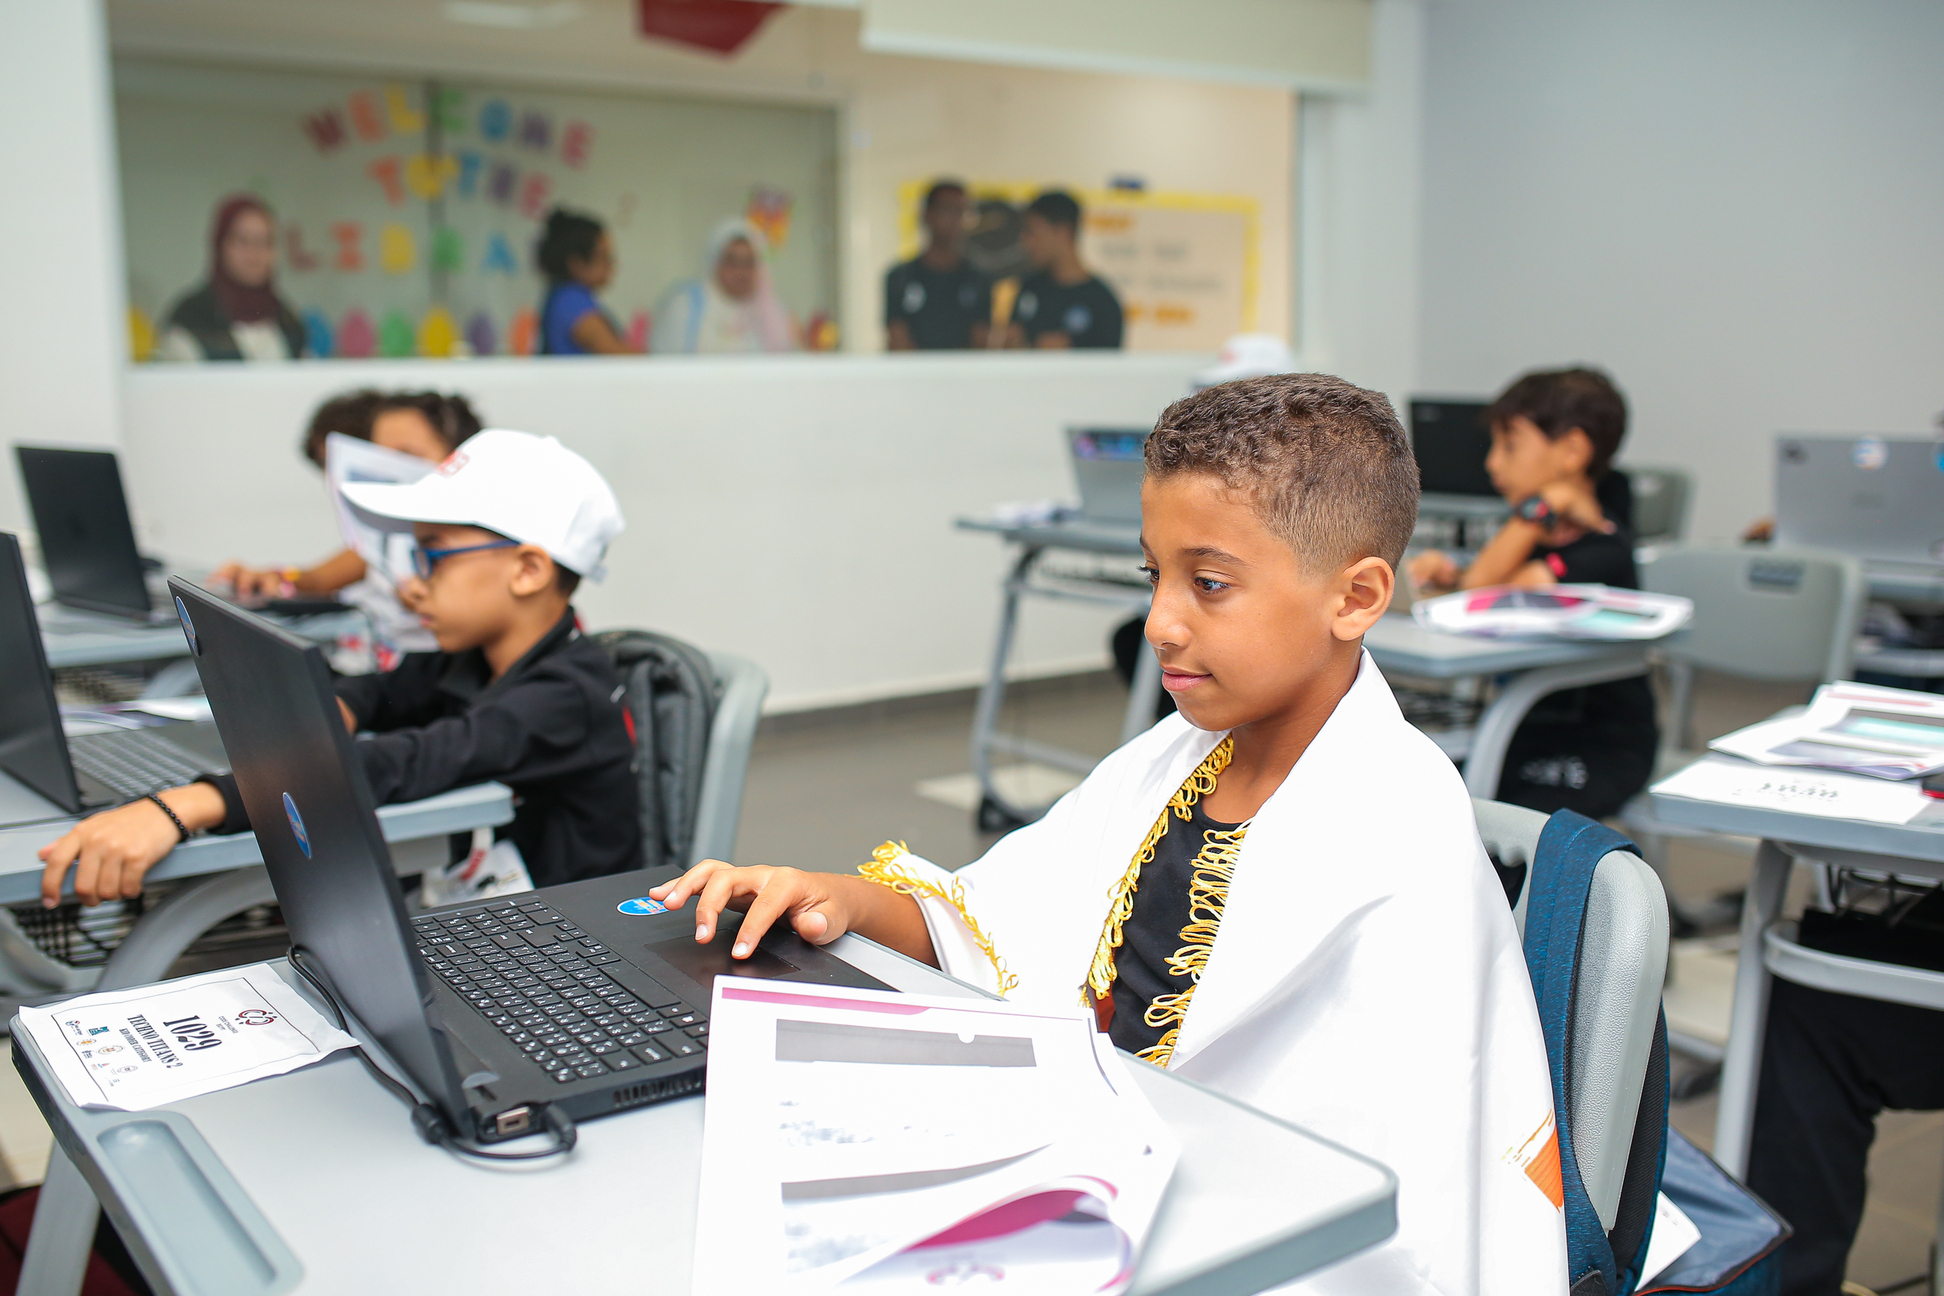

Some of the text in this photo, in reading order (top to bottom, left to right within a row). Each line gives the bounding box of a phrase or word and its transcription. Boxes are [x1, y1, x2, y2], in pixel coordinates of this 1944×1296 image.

[127, 1014, 160, 1040] TECHNO
[146, 1039, 180, 1064] TITANS
[162, 1015, 222, 1051] 1029
